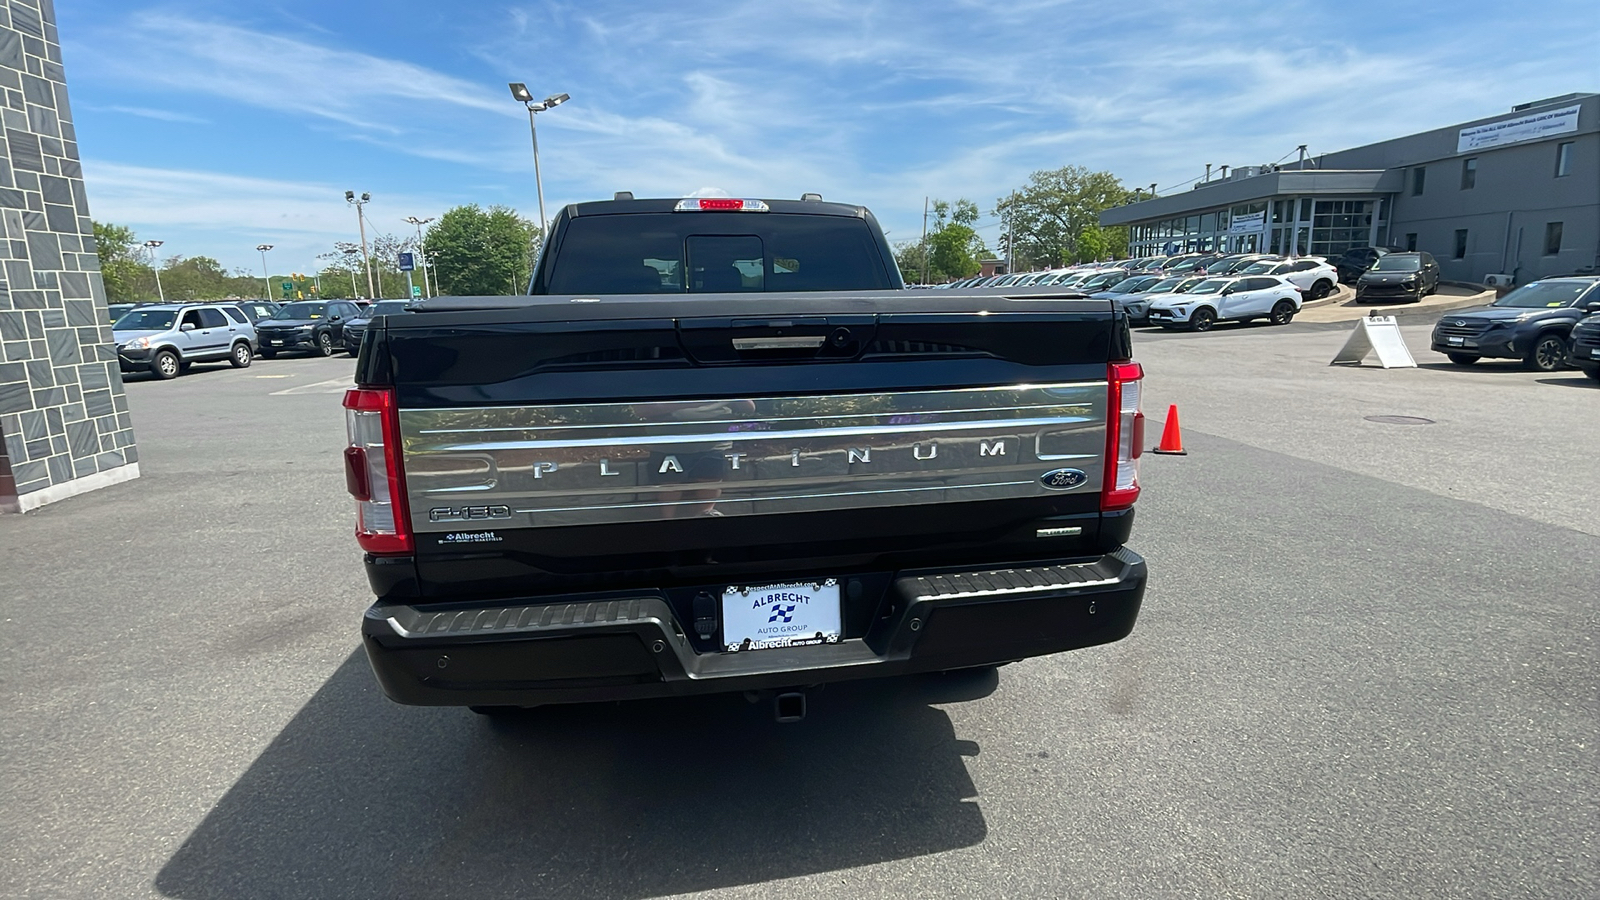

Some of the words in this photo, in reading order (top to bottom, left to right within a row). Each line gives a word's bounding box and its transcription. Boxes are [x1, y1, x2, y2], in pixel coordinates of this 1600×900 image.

[532, 442, 1007, 479] PLATINUM
[1051, 471, 1078, 485] Ford
[429, 504, 512, 522] F-150
[455, 531, 495, 540] Albrecht
[752, 592, 810, 609] ALBRECHT
[757, 626, 779, 634] AUTO
[780, 624, 808, 632] GROUP
[748, 638, 792, 650] Albrecht
